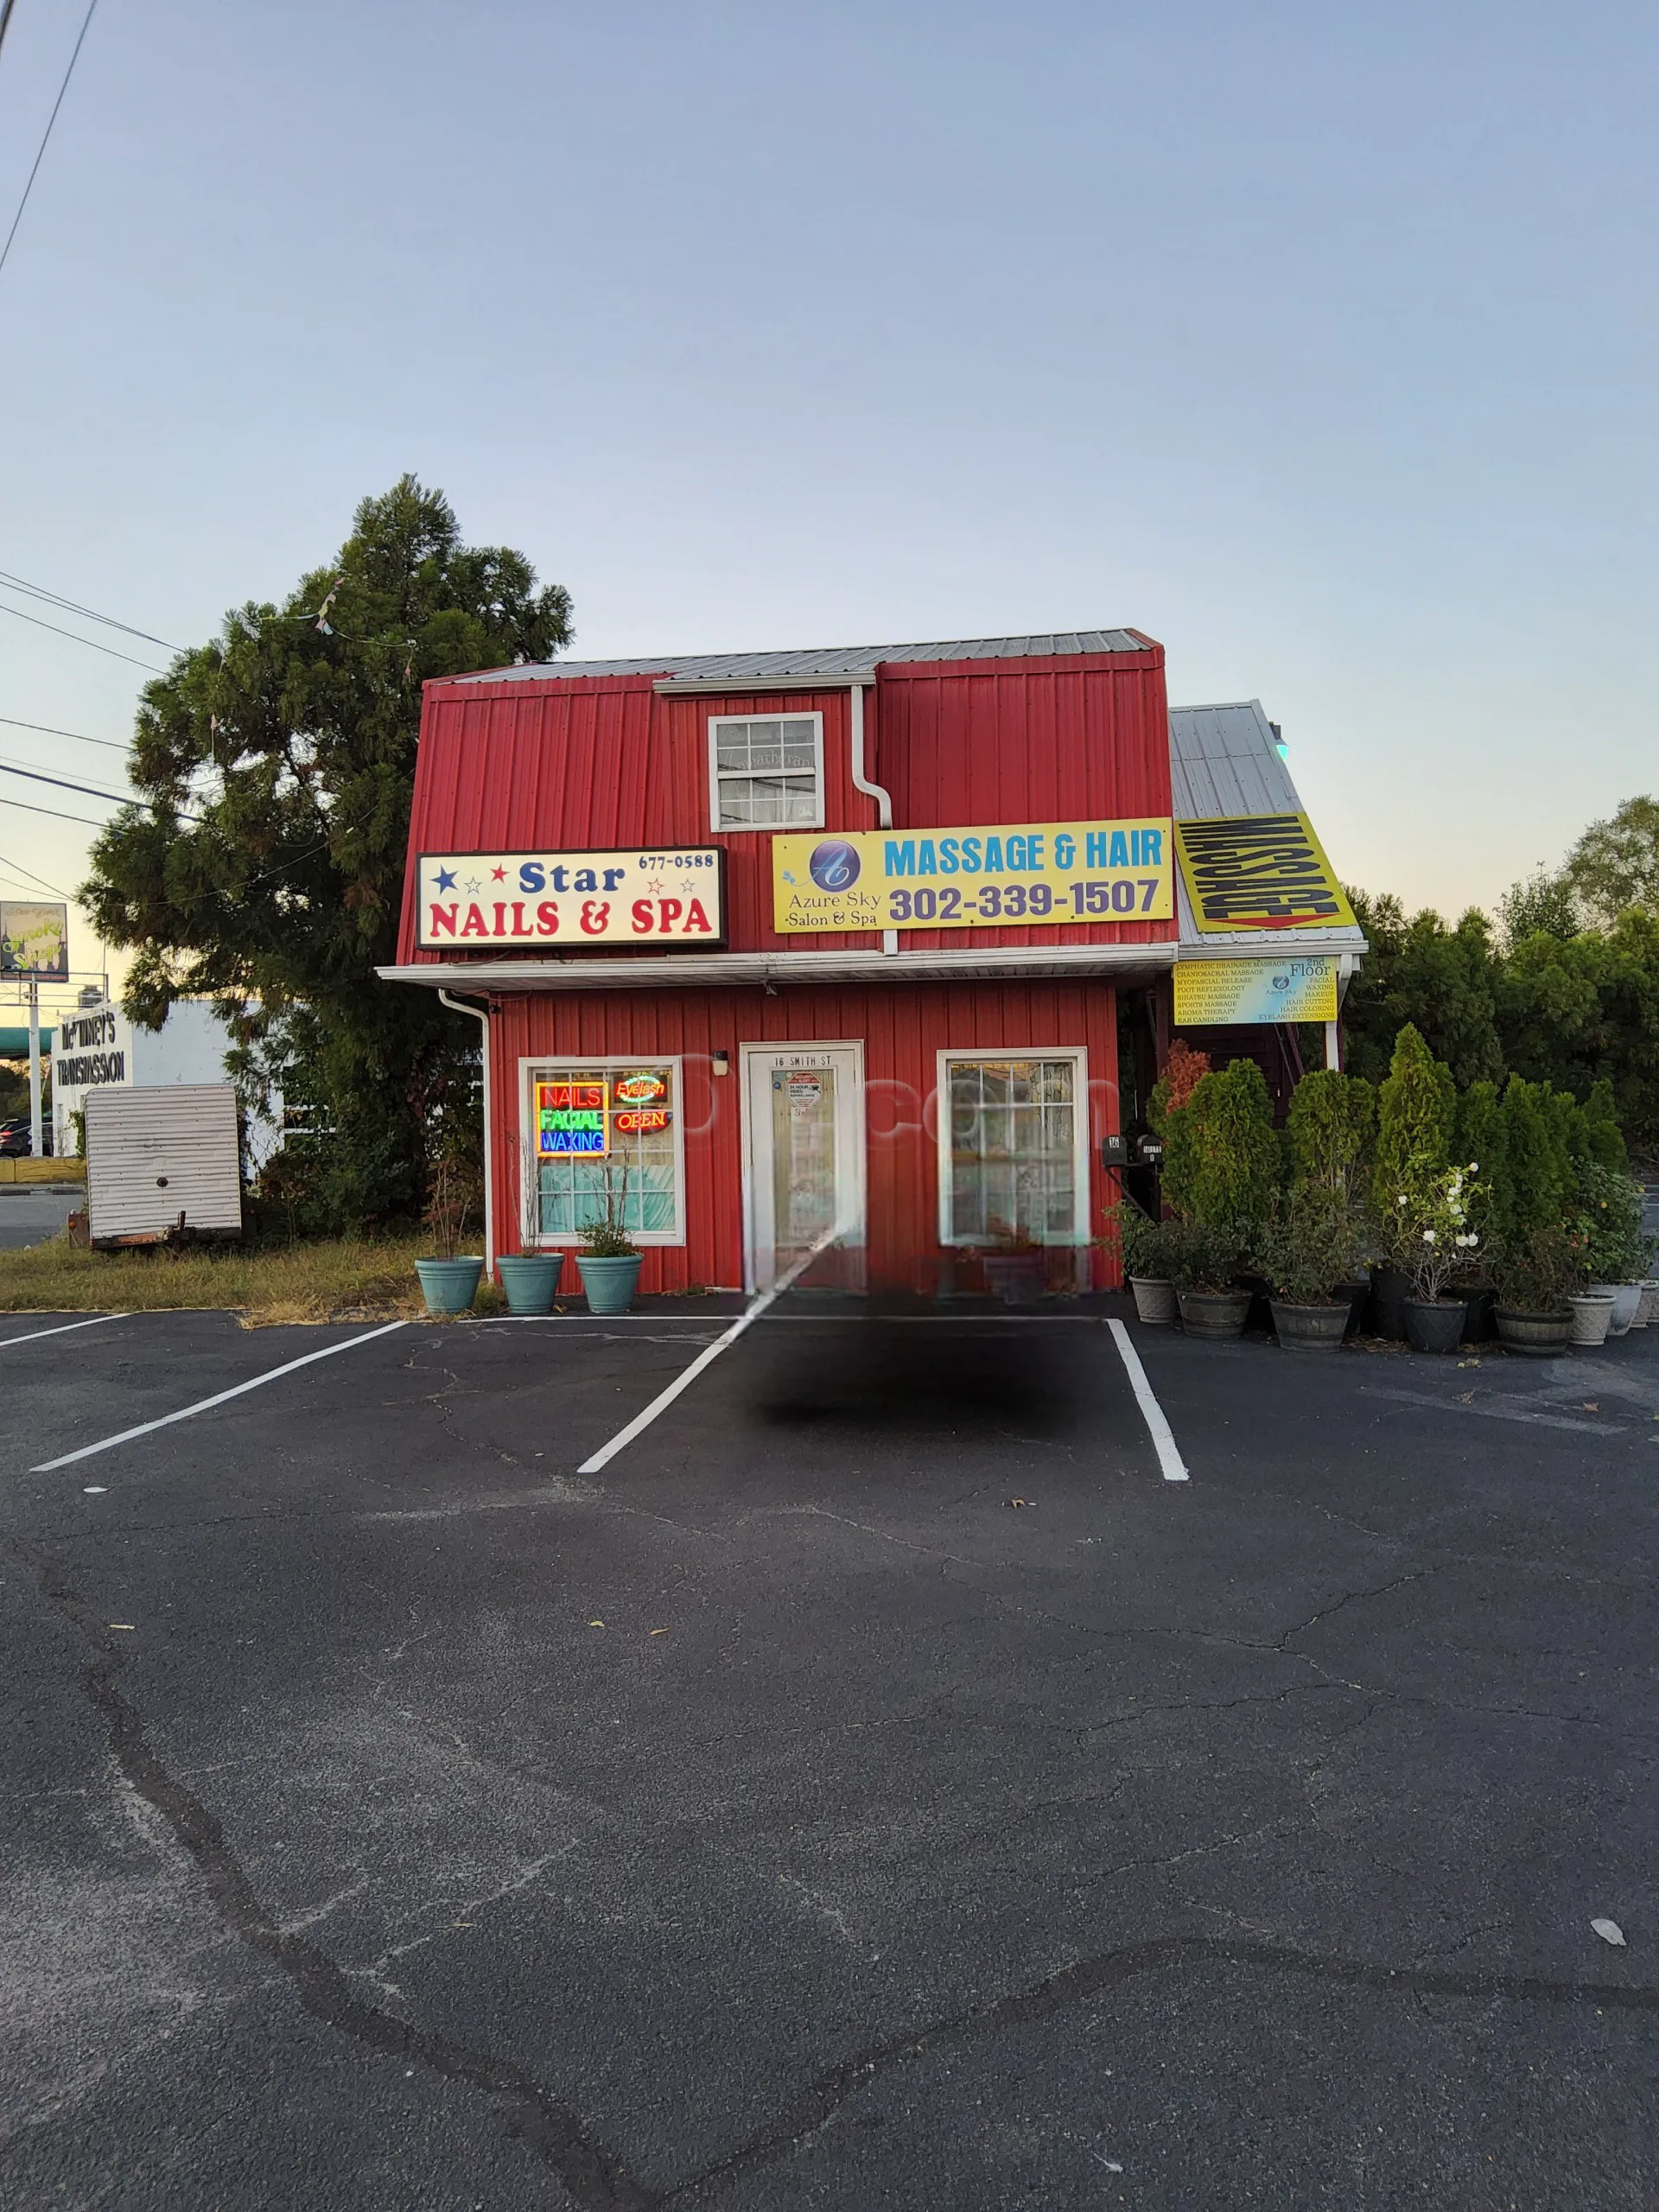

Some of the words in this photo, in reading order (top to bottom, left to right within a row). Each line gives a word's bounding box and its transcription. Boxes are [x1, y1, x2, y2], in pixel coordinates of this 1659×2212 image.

[639, 855, 714, 870] 677-0588
[884, 835, 1045, 877] MASSAGE
[1054, 834, 1077, 870] &
[1085, 830, 1162, 869] HAIR
[1179, 816, 1340, 918] MASSAGE
[518, 862, 626, 893] Star
[788, 893, 840, 908] Azure
[847, 892, 881, 911] Sky
[889, 879, 1160, 921] 302-339-1507
[429, 901, 560, 938] NAILS
[580, 900, 611, 935] &
[632, 898, 713, 934] SPA
[788, 912, 829, 926] Salon
[833, 911, 845, 925] &
[850, 911, 877, 926] Spa
[1290, 963, 1331, 976] Floor
[1306, 957, 1325, 967] 2nd
[57, 1051, 124, 1086] TRANSMISSION
[775, 1057, 785, 1066] 16
[790, 1056, 816, 1066] SMITH
[821, 1055, 831, 1065] ST
[543, 1088, 601, 1107] NAILS
[616, 1081, 664, 1098] Eyelash
[619, 1112, 665, 1129] OPEN
[540, 1132, 604, 1151] WAXING
[1109, 1136, 1120, 1148] 16
